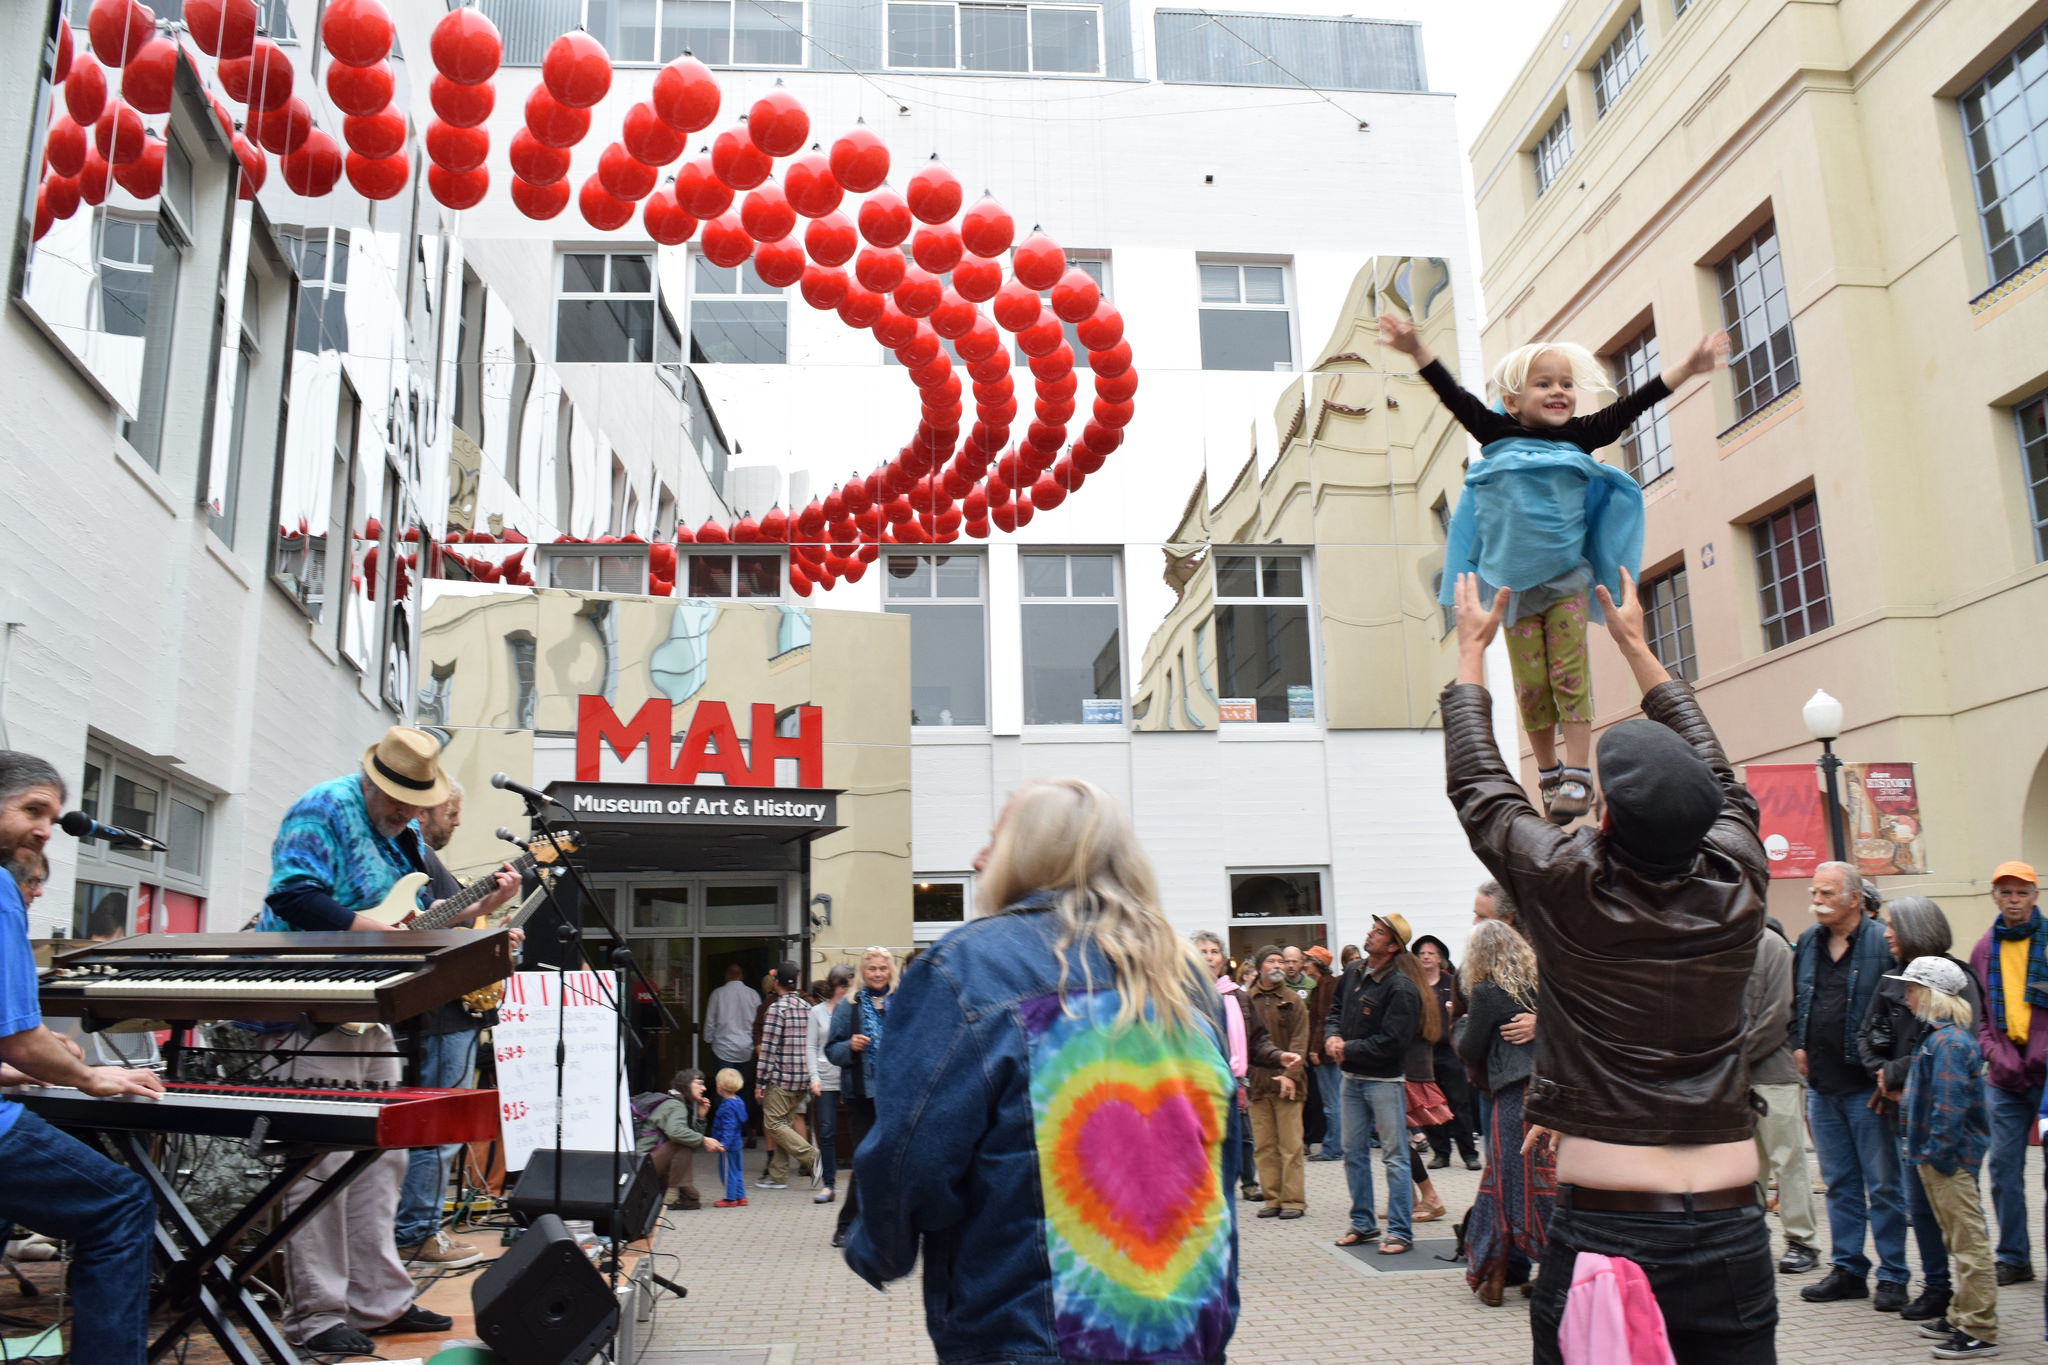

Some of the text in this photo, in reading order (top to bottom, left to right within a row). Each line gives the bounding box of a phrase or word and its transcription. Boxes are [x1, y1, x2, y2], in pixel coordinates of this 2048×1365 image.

[576, 694, 823, 788] MAH
[573, 794, 827, 821] Museum of Art & History
